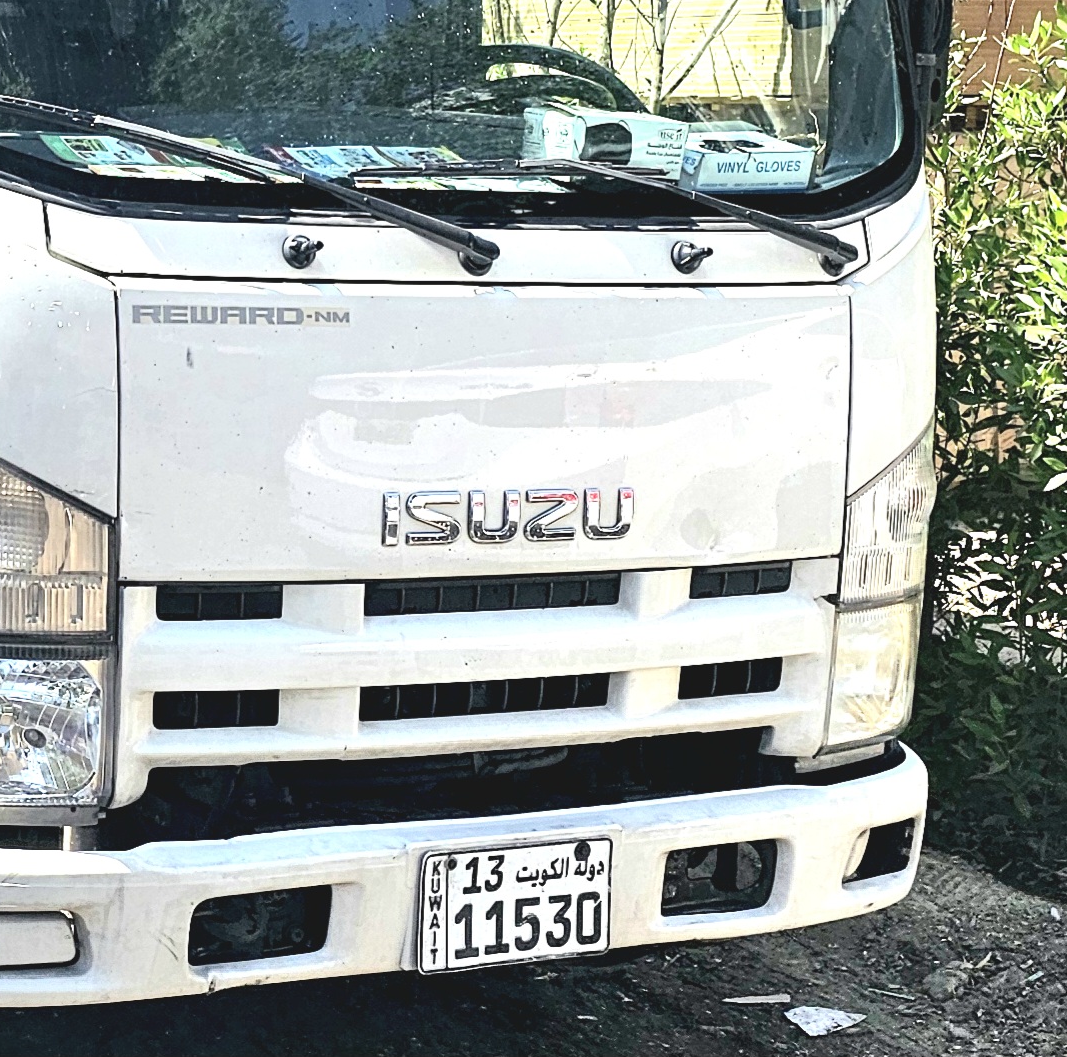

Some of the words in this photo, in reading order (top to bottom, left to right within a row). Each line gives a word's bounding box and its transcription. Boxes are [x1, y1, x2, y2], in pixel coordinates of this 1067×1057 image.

[717, 161, 750, 173] VINYL
[755, 160, 802, 173] GLOVES
[381, 486, 635, 547] ISUZU
[462, 855, 506, 894] 13
[515, 856, 570, 888] الكويت
[428, 860, 443, 965] KUWAIT
[454, 891, 603, 960] 11530
